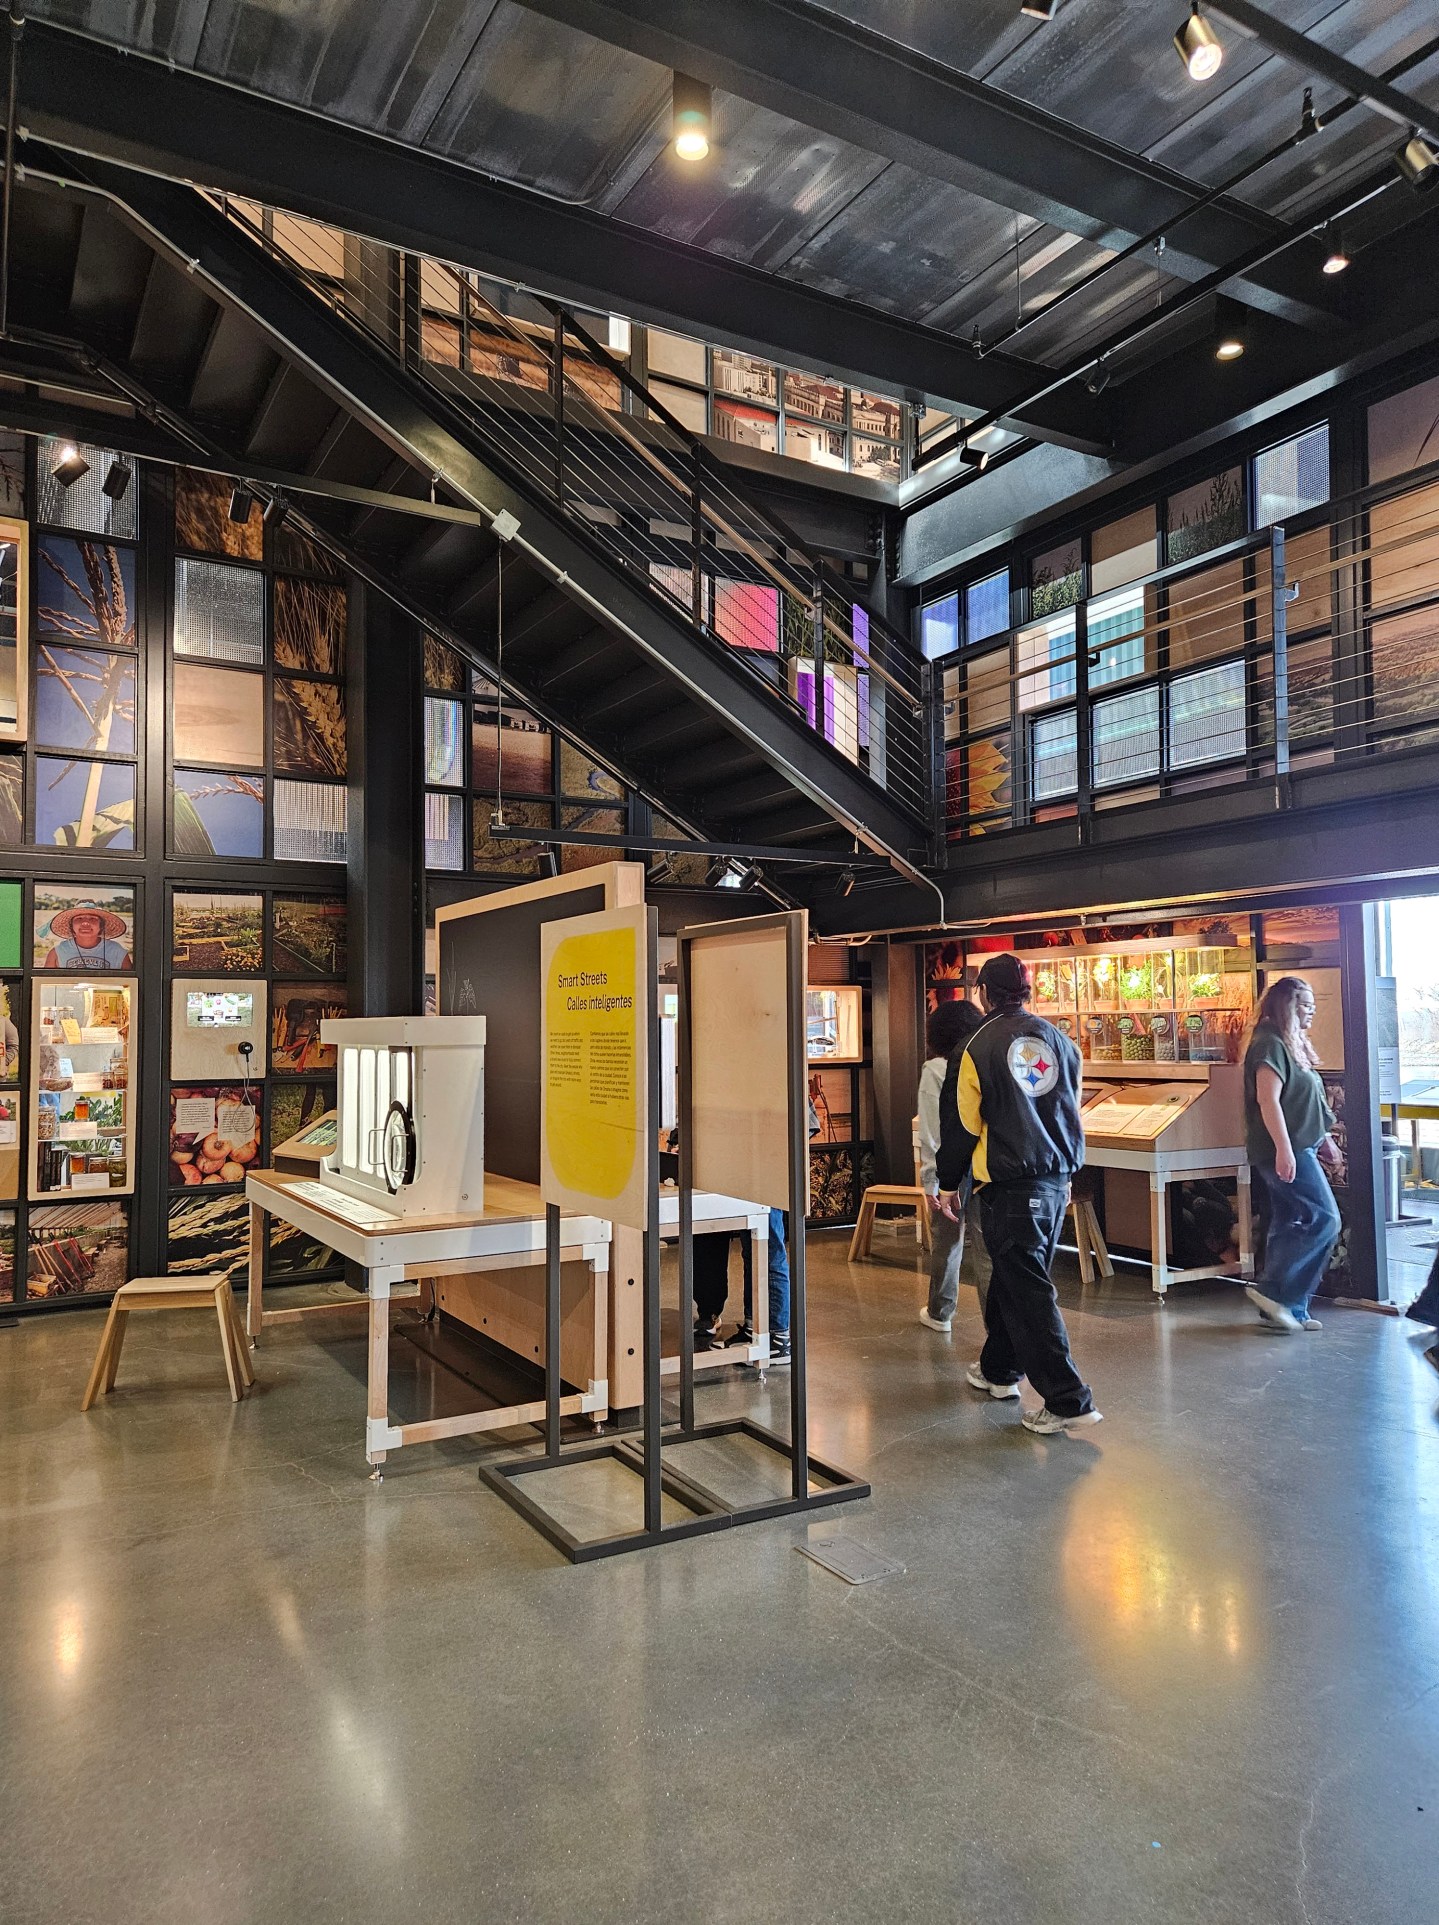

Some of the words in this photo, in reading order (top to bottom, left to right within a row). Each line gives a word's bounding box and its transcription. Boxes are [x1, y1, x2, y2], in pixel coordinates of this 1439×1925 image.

[558, 974, 578, 988] Smart
[580, 971, 607, 986] Streets
[567, 996, 587, 1010] Calles
[589, 994, 632, 1012] inteligentes
